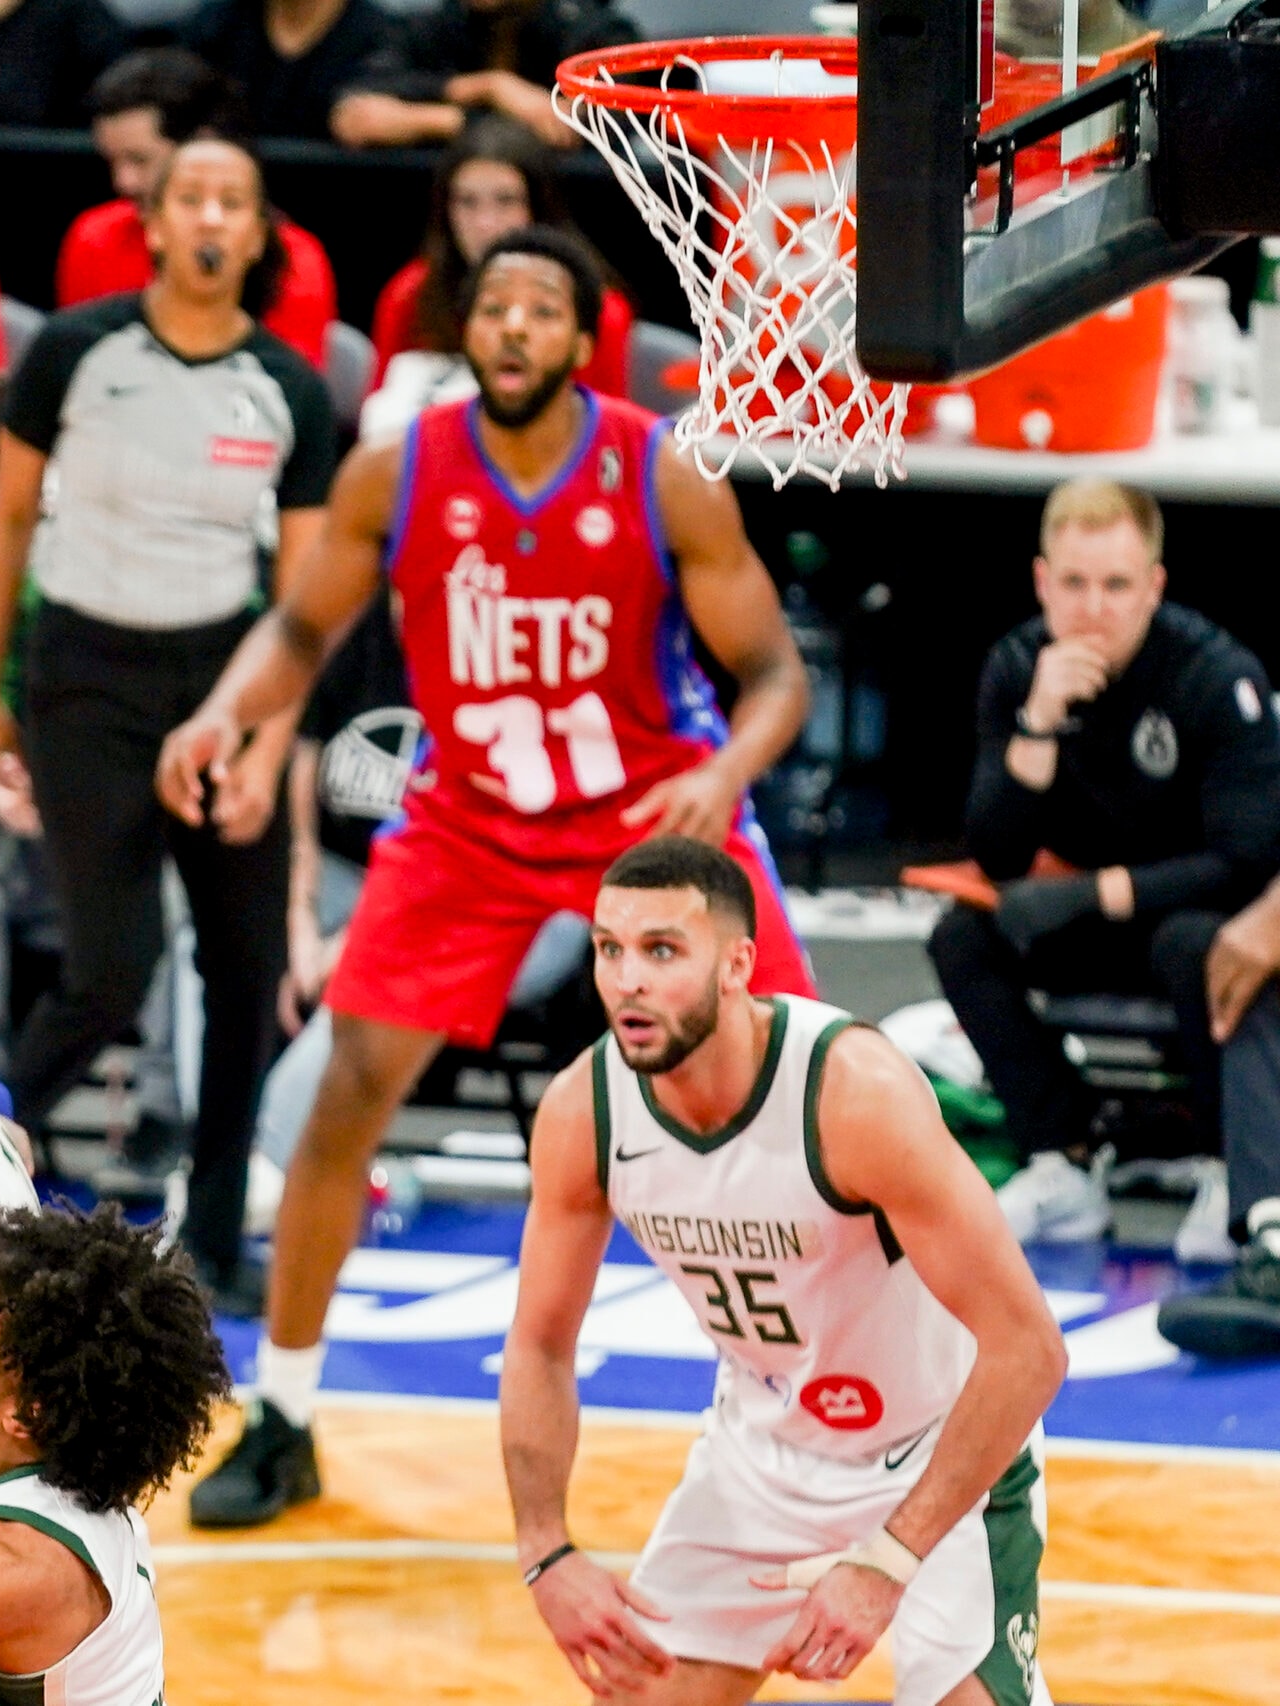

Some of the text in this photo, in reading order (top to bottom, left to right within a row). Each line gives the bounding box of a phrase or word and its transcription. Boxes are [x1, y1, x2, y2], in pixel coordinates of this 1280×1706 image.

[448, 594, 613, 691] NETS
[453, 691, 626, 814] 31
[680, 1263, 802, 1345] 35
